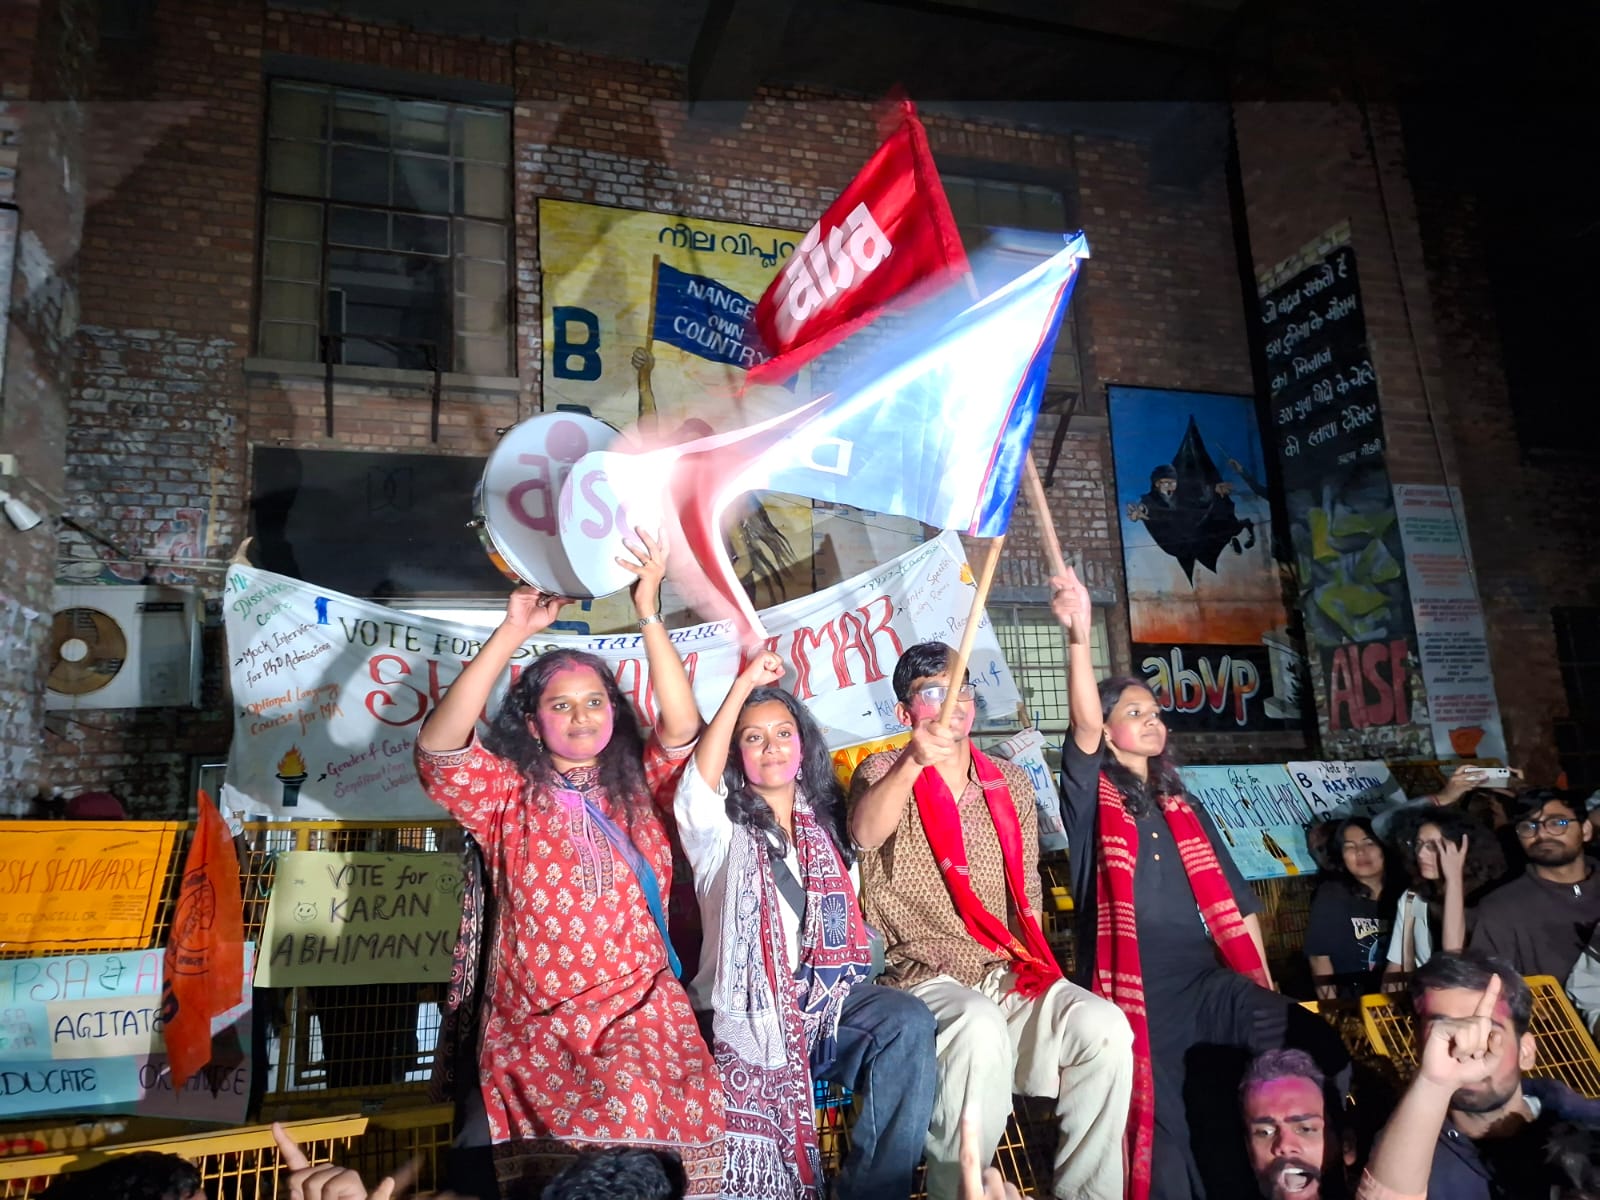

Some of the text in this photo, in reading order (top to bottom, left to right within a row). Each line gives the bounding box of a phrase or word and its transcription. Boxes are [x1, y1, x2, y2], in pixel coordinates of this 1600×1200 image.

[673, 315, 771, 370] COUNTRY
[708, 315, 744, 341] OWN
[337, 616, 422, 653] VOTE
[432, 634, 482, 658] FOR
[242, 640, 274, 668] Mock
[246, 670, 262, 689] for
[263, 656, 283, 677] PhD
[1142, 646, 1260, 726] abvp
[326, 863, 430, 889] VOTE for
[328, 893, 432, 925] KARAN
[54, 1007, 164, 1044] AGITATE
[0, 1067, 97, 1096] DUCATE
